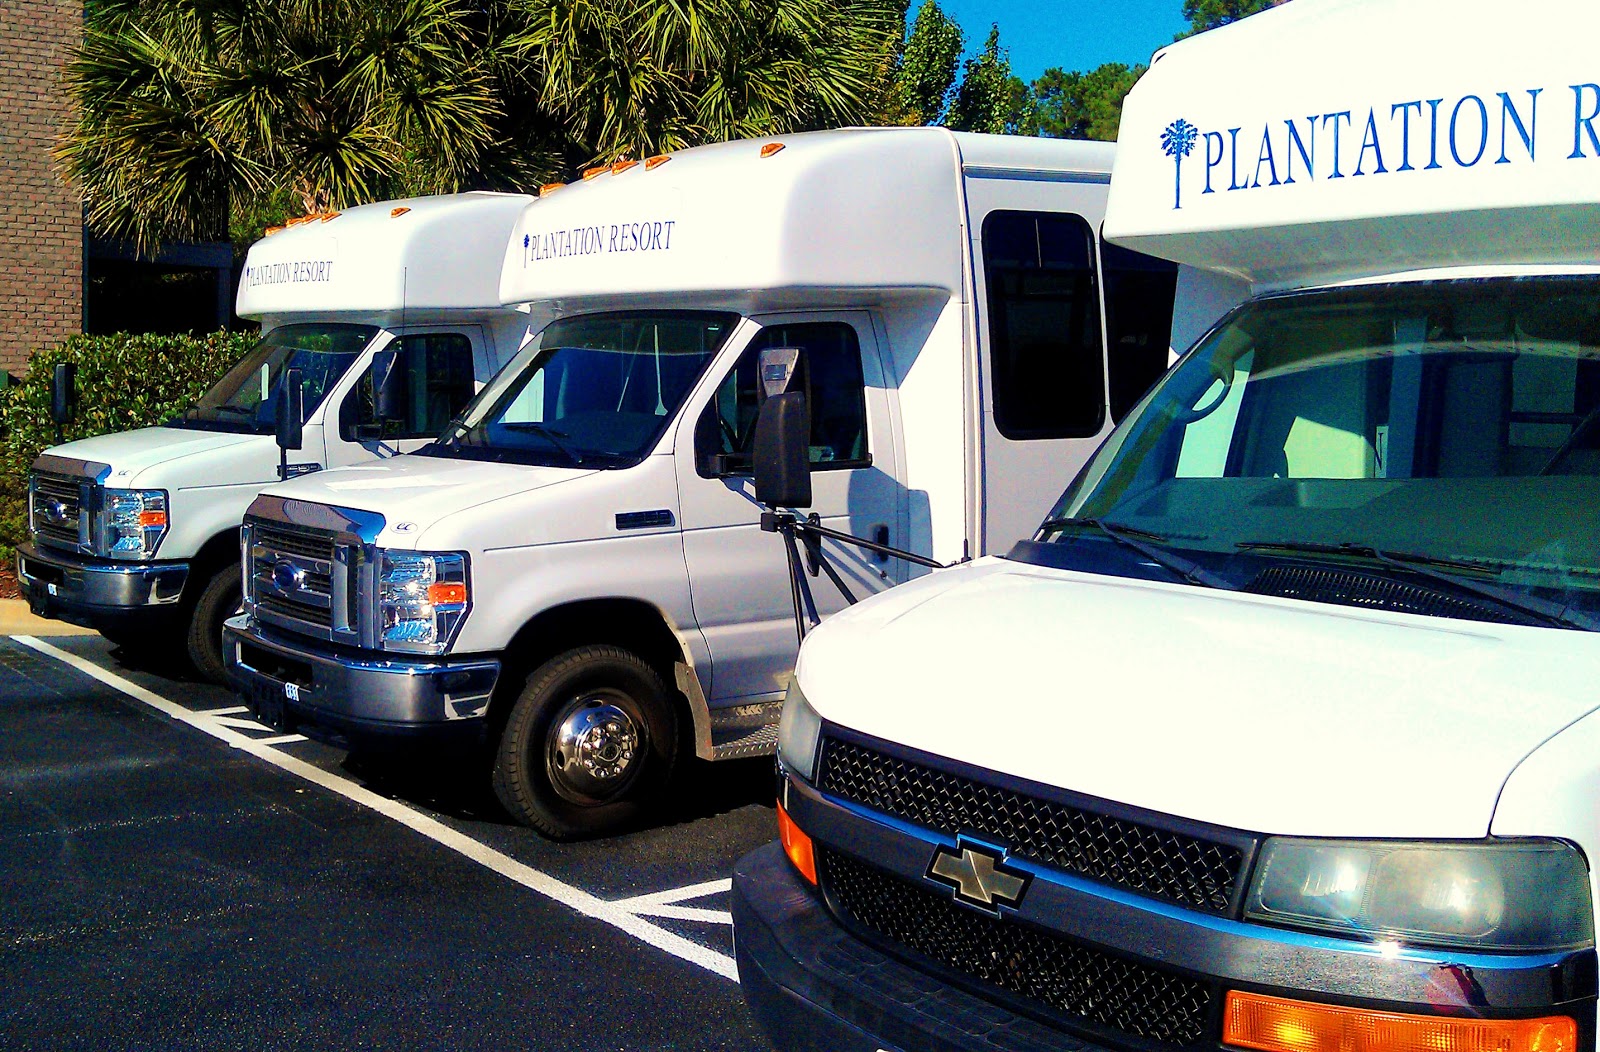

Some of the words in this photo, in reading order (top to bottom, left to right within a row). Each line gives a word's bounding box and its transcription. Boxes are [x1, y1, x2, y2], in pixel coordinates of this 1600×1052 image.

[1202, 88, 1544, 194] PLANTATION
[531, 226, 605, 261] PLANTATION
[608, 221, 675, 252] RESORT
[249, 263, 292, 287] PLANTATION
[293, 261, 333, 282] RESORT
